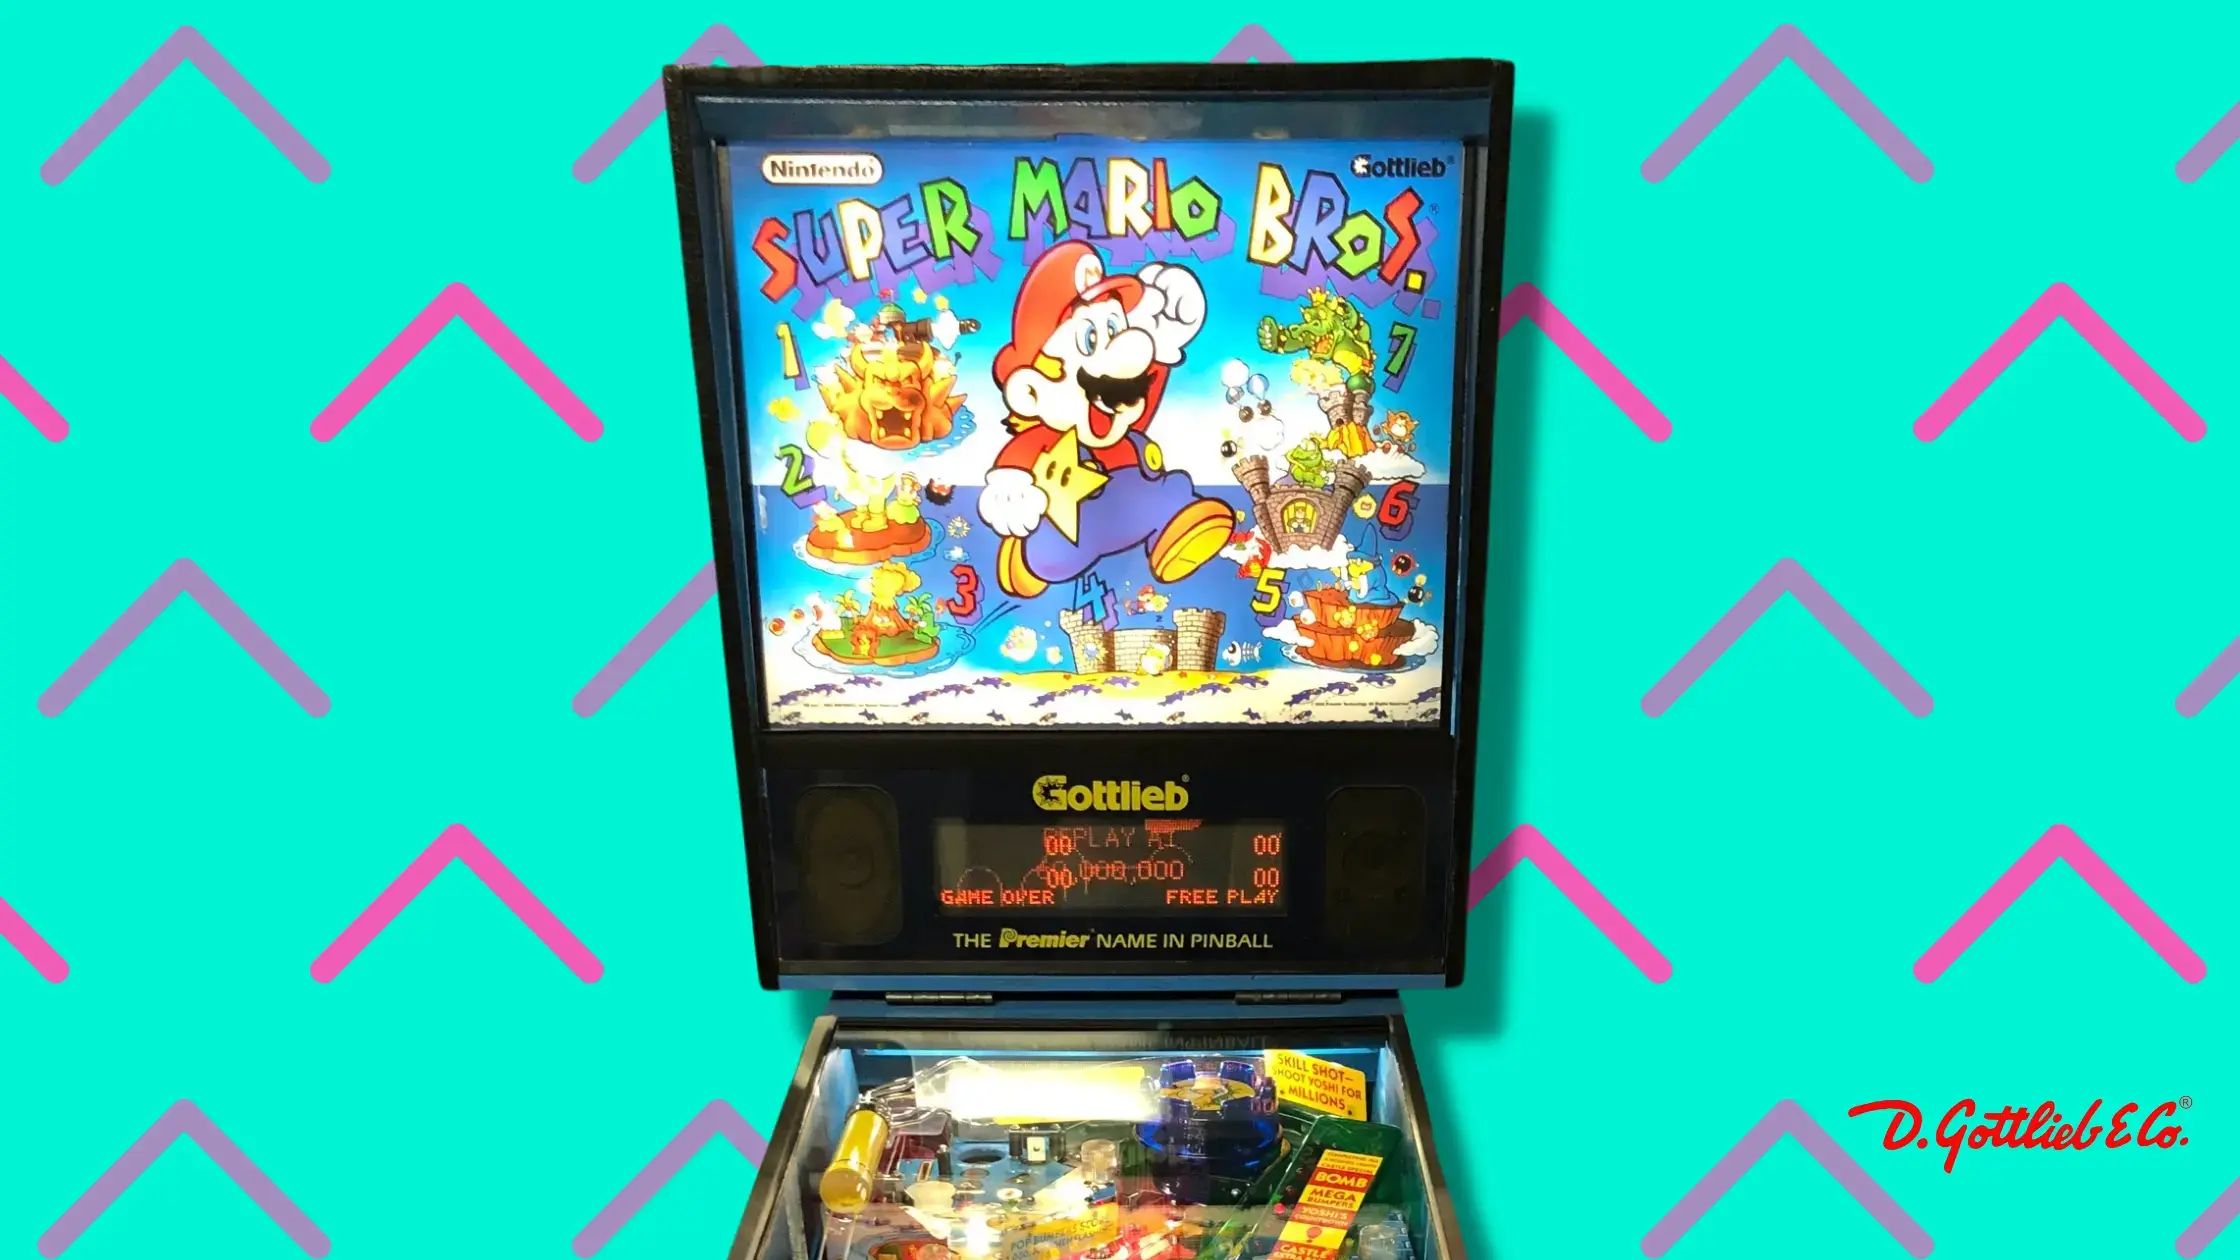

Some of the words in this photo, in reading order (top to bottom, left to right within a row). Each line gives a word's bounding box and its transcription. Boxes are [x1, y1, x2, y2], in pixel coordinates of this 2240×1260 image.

[770, 159, 875, 179] Nintendo
[1350, 154, 1446, 179] Gottlieb
[752, 177, 984, 303] SUPER
[1008, 156, 1223, 242] MARIO
[774, 443, 814, 497] 2
[1376, 480, 1419, 528] 6
[946, 564, 981, 617] 3
[1250, 567, 1287, 616] 5
[1032, 774, 1189, 812] Gottlieb
[941, 889, 995, 905] GAME
[1001, 889, 1055, 905] OVER
[1165, 889, 1219, 905] FREE
[1226, 889, 1280, 905] PLAY
[952, 933, 992, 948] THE
[998, 927, 1092, 949] Premier
[1096, 933, 1157, 949] NAME
[1163, 933, 1185, 949] IN
[1190, 933, 1274, 949] PINBALL
[1277, 1053, 1309, 1073] SKILL
[1288, 1084, 1346, 1111] MILLIONS
[1307, 1076, 1339, 1093] YOSHI
[1341, 1086, 1362, 1101] FOR
[1315, 1171, 1369, 1189] BOMB
[1307, 1196, 1355, 1210] BUMPERS
[1309, 1188, 1357, 1203] MEGA
[1301, 1206, 1349, 1220] YOSHI'S
[1280, 1243, 1329, 1259] CASTLE
